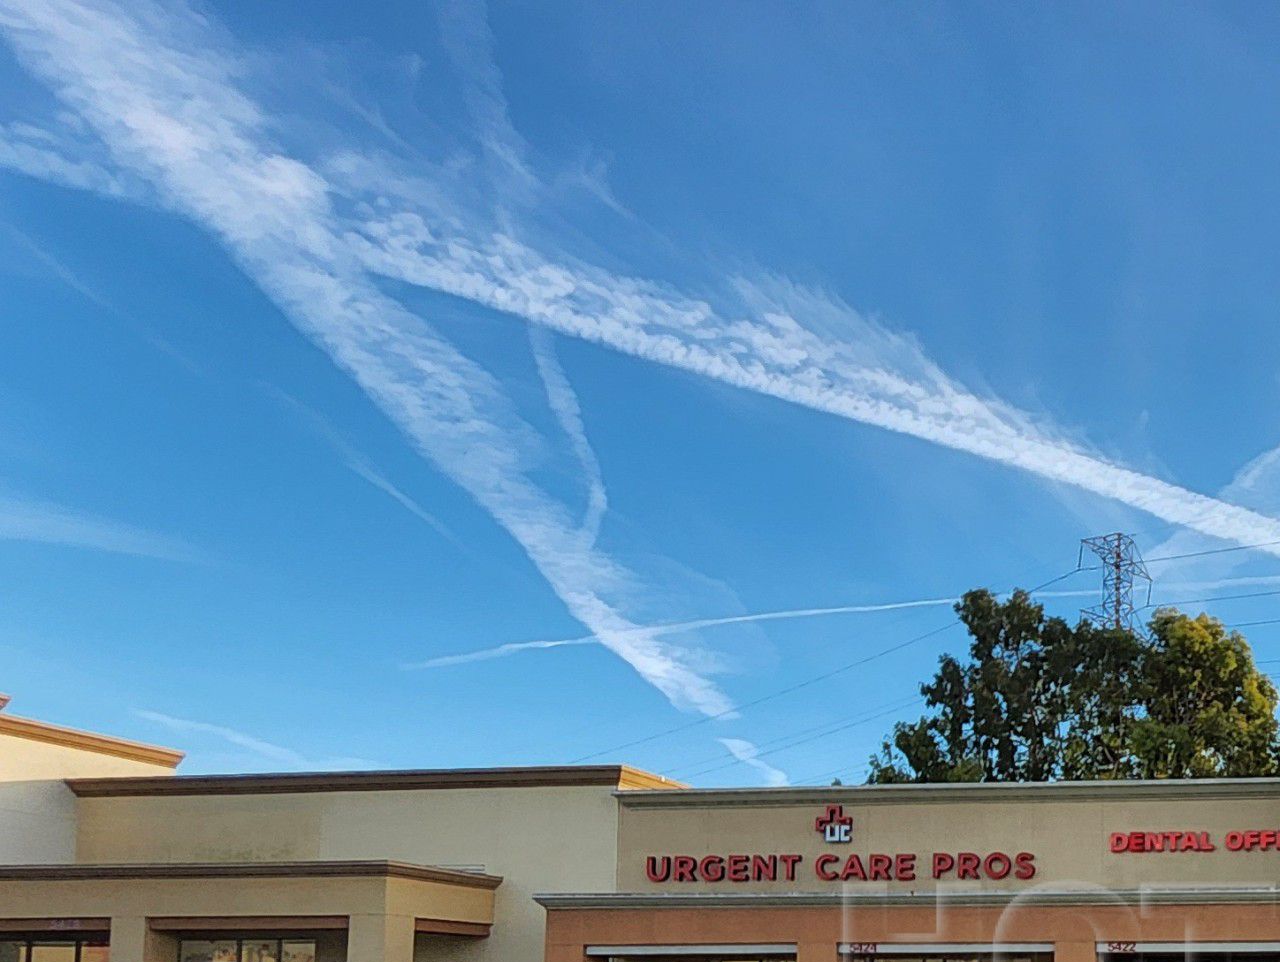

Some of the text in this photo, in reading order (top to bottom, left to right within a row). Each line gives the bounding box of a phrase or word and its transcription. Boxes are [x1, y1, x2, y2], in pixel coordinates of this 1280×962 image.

[825, 824, 852, 842] UC
[1110, 832, 1214, 852] DENTAL
[646, 852, 1036, 882] URGENT CARE PROS
[1107, 942, 1137, 952] 5422
